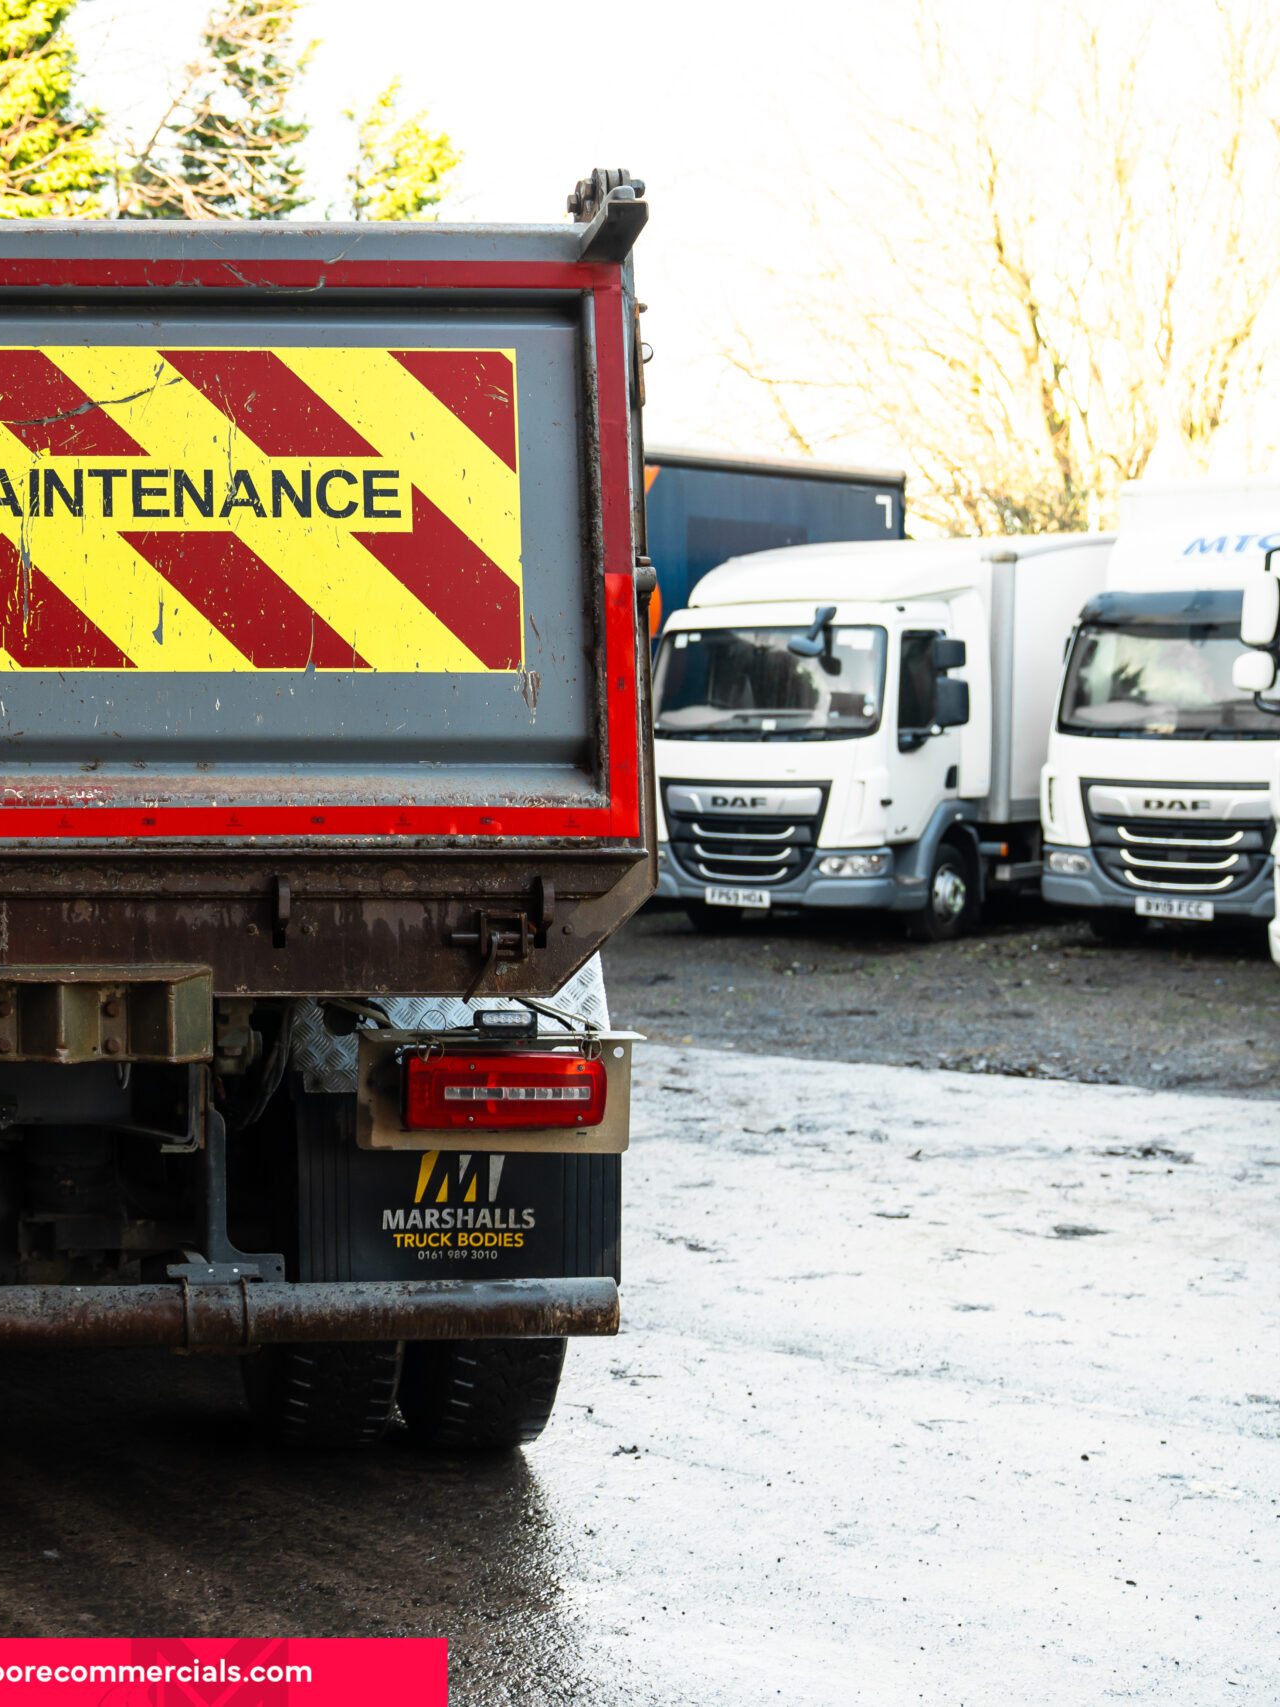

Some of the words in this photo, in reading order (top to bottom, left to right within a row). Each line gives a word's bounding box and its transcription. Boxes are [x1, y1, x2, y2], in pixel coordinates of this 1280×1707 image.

[711, 796, 767, 808] DAF
[1144, 799, 1210, 811] DAF
[382, 1208, 536, 1231] MARSHALLS
[393, 1232, 452, 1248] TRUCK
[457, 1231, 524, 1248] BODIES
[417, 1250, 443, 1260] 0161
[447, 1250, 468, 1260] 989
[471, 1250, 498, 1260] 3010
